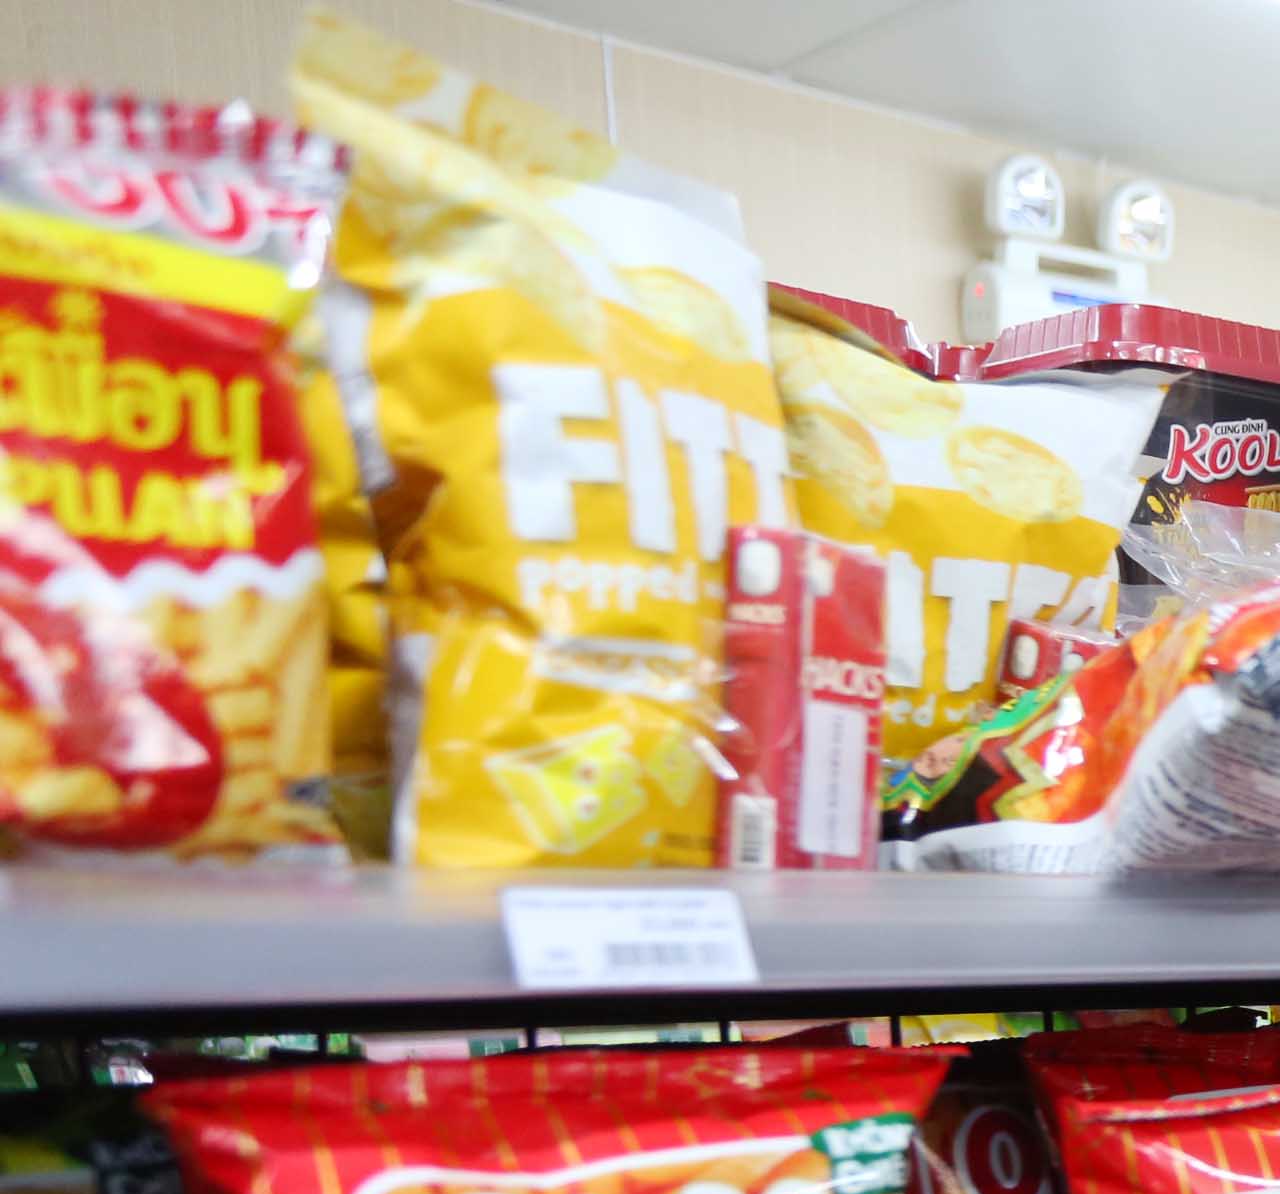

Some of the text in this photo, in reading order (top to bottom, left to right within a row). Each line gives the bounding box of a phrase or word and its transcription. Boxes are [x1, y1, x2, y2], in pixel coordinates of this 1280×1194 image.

[1212, 418, 1265, 436] CUNG ĐÌNH
[803, 656, 885, 699] HACKS
